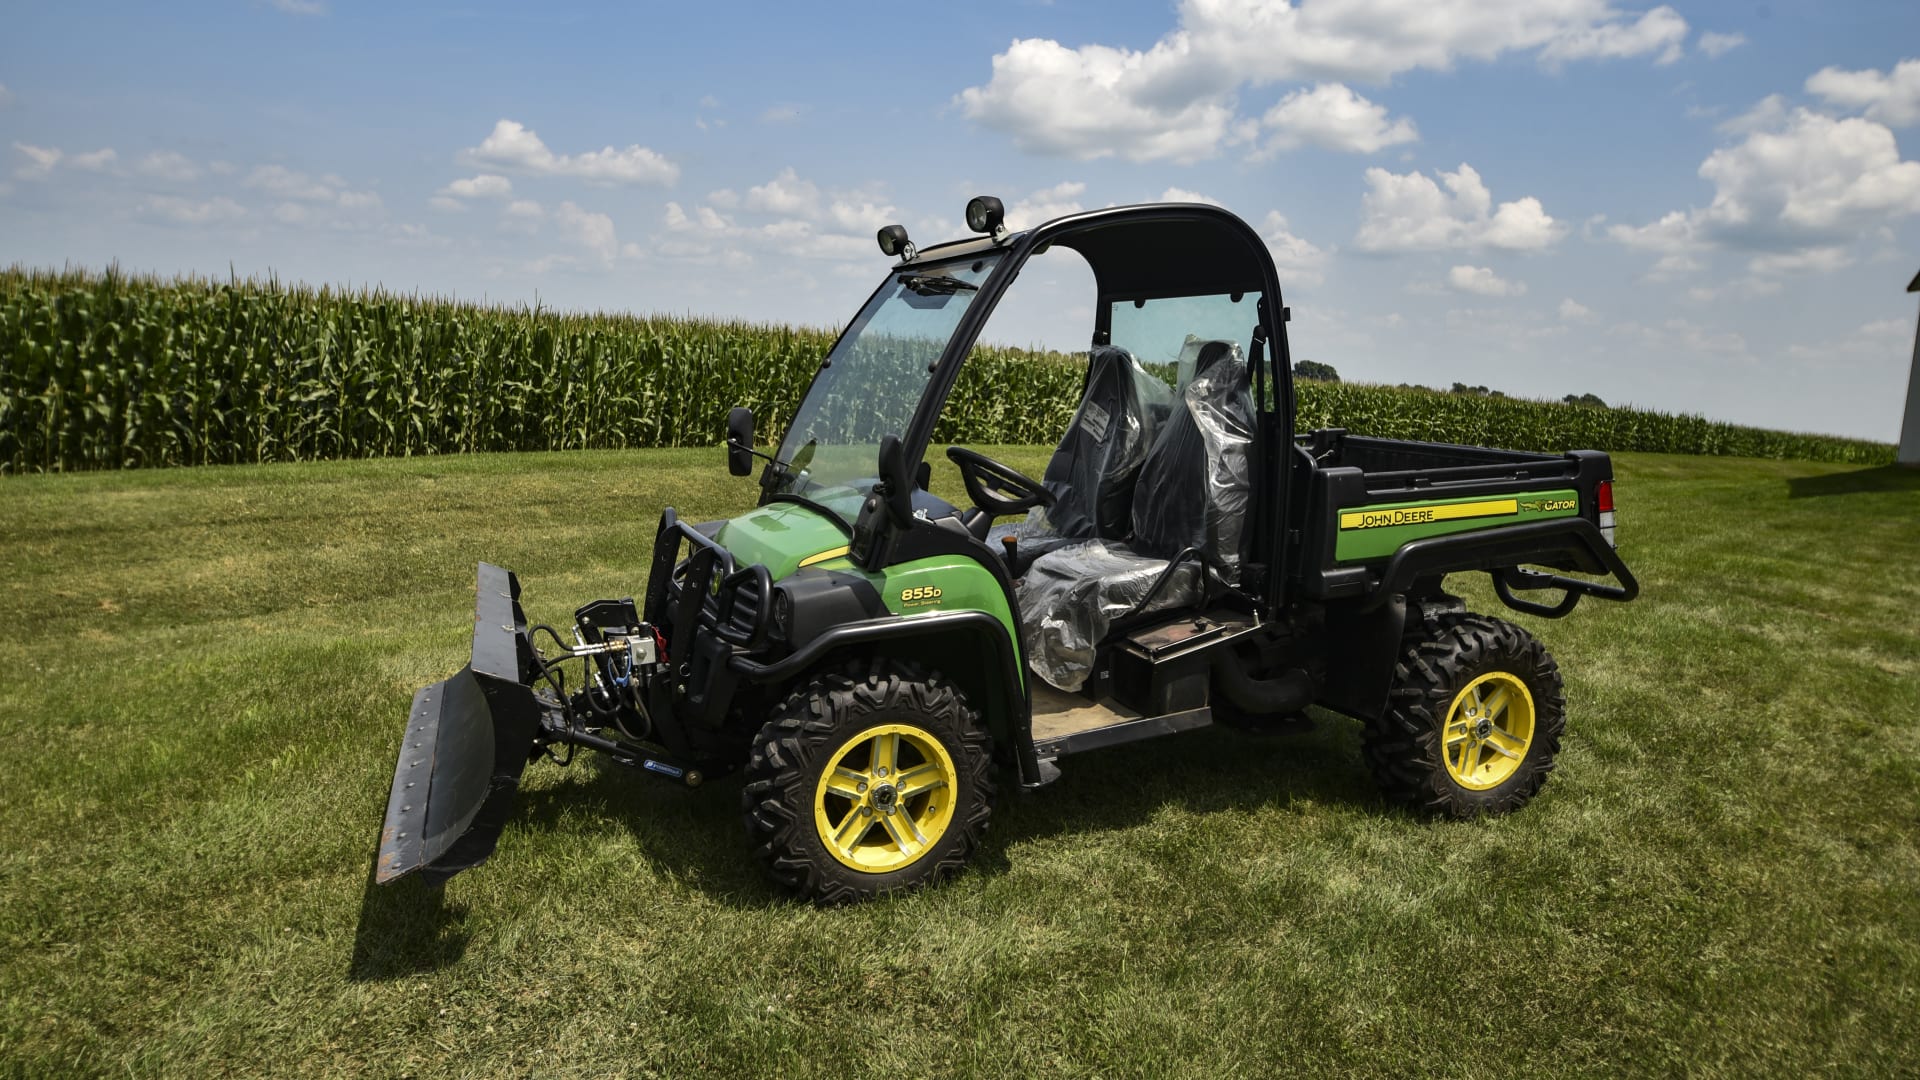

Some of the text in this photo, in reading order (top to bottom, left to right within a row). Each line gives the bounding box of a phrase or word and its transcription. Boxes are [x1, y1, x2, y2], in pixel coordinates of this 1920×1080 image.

[1544, 500, 1576, 511] GATOR
[1358, 510, 1434, 527] JOHN DEERE
[901, 586, 942, 601] 855D
